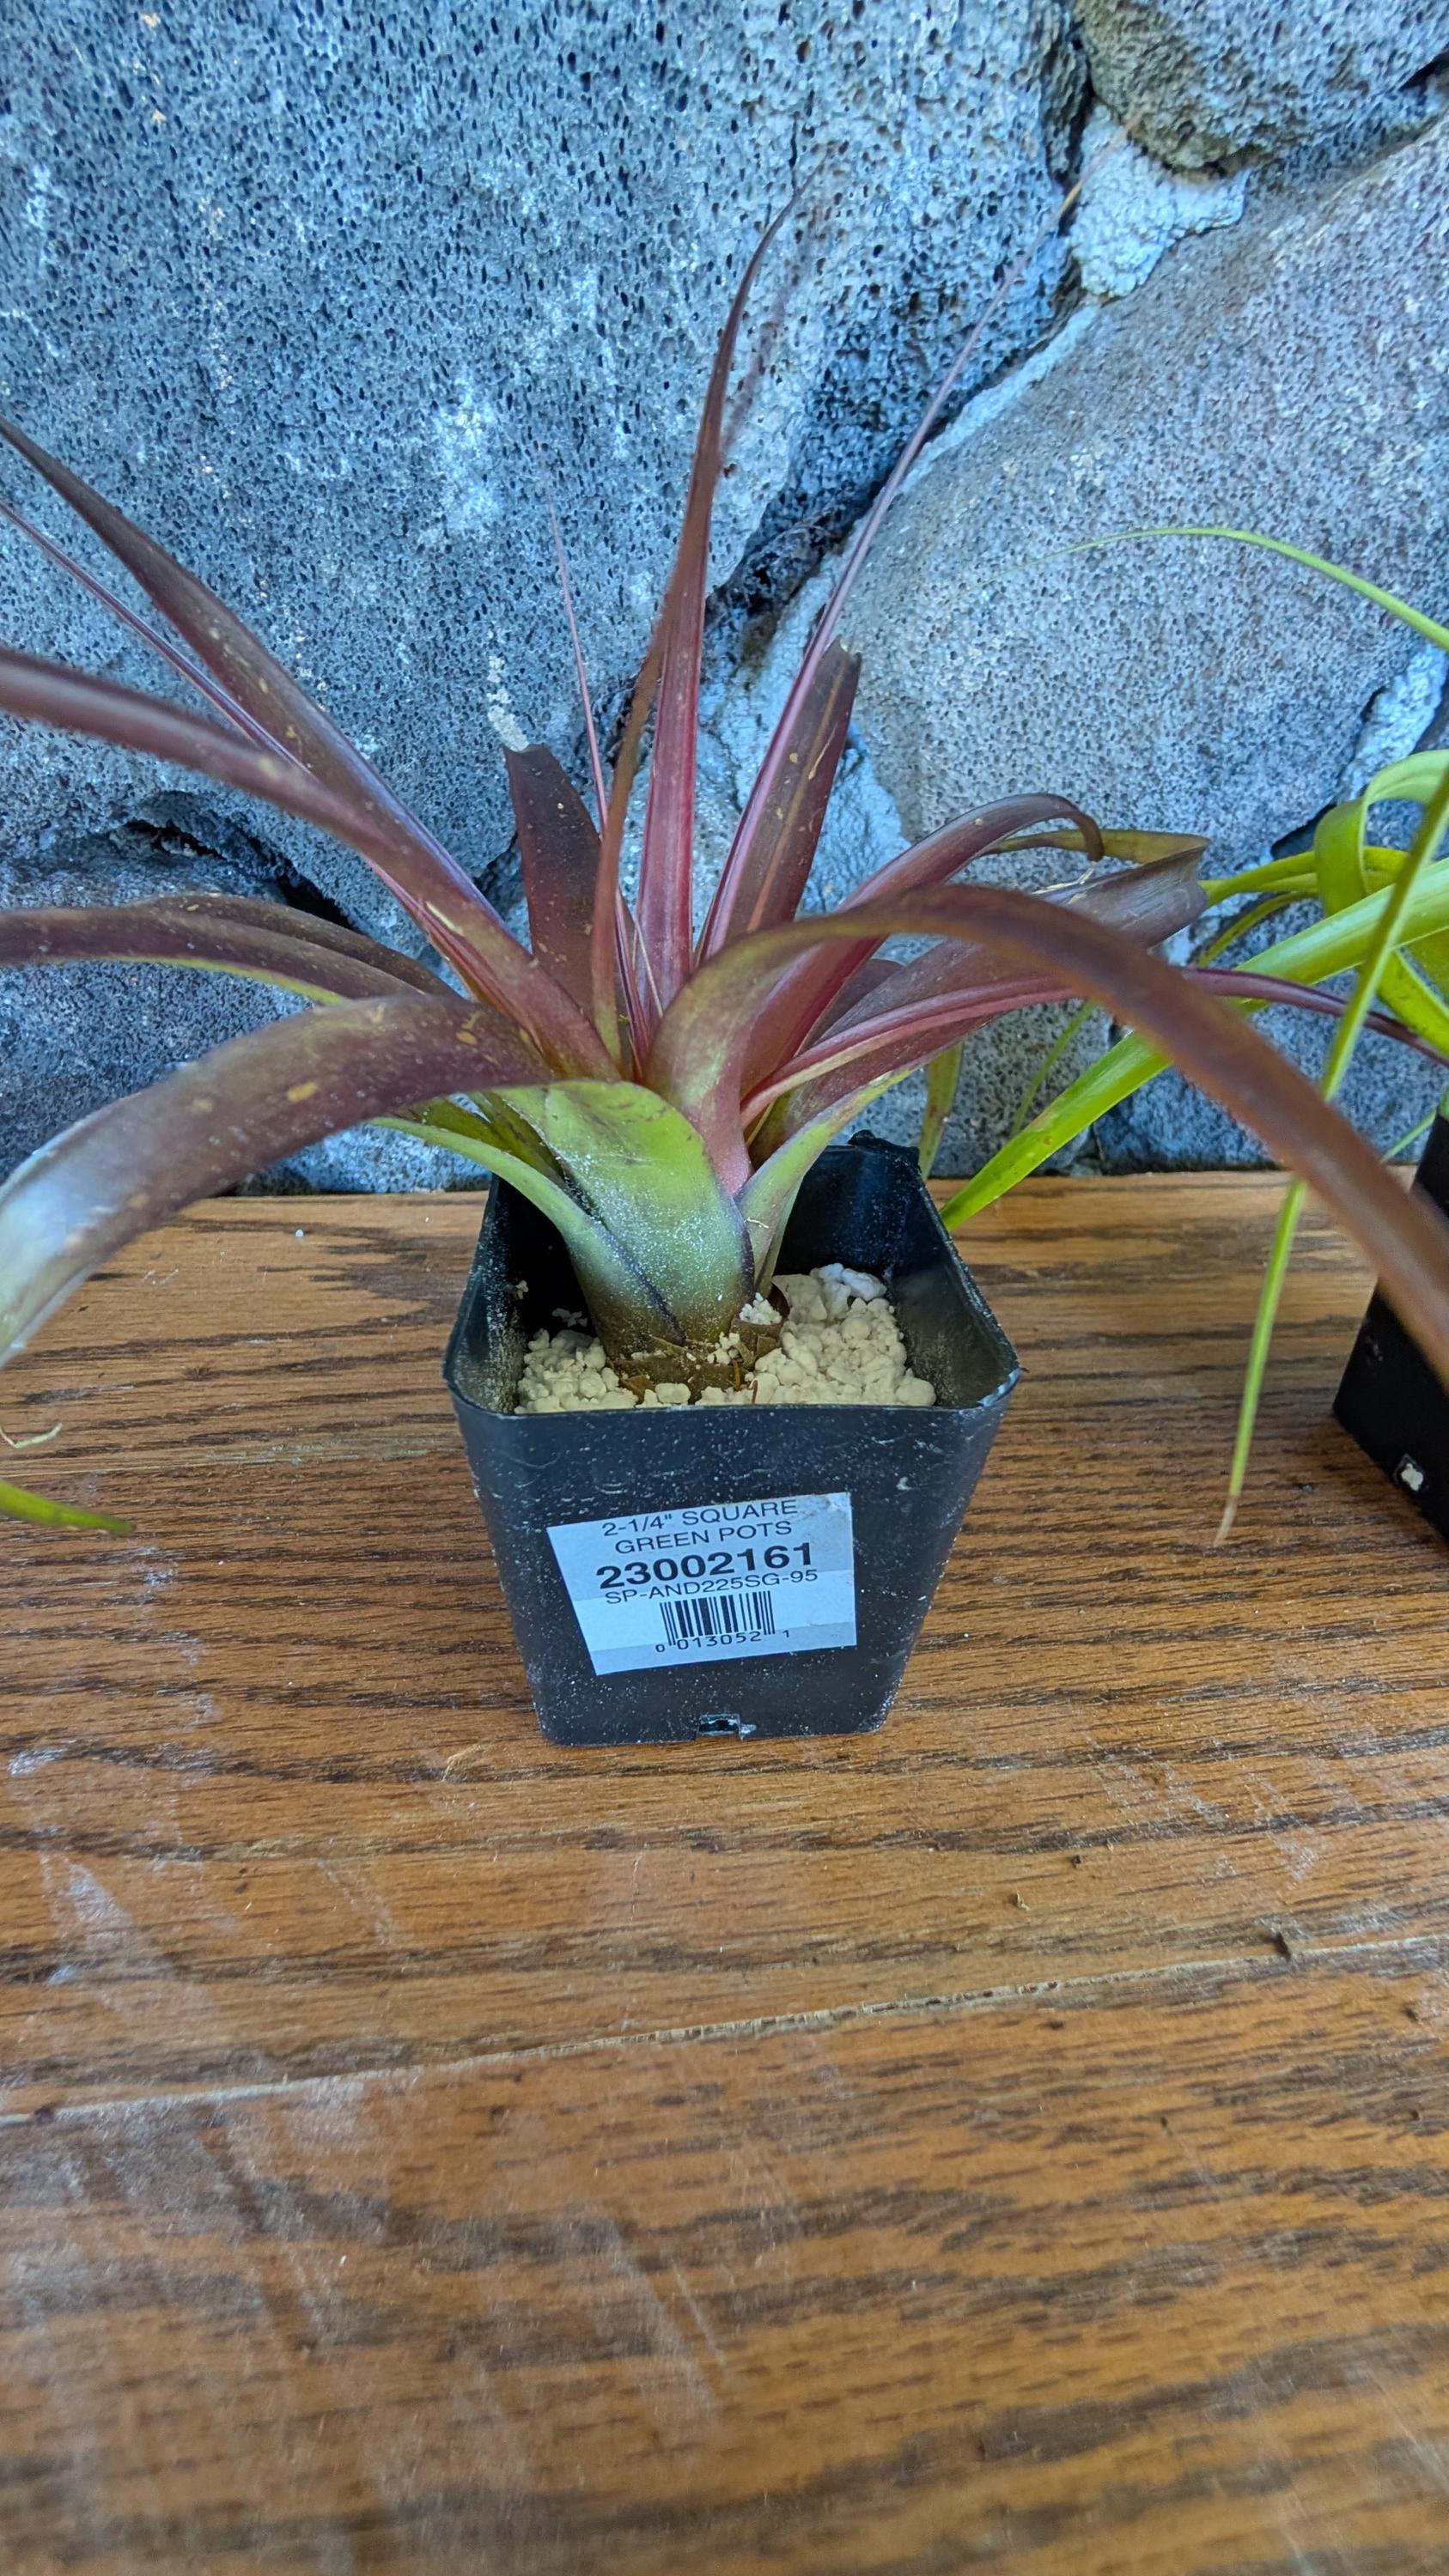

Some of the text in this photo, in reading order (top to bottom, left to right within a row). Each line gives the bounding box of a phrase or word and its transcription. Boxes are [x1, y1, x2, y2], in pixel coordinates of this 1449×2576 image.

[602, 1499, 798, 1537] 2-1/4" SQUARE
[615, 1521, 792, 1554] GREEN POTS
[596, 1542, 813, 1589] 23002161
[606, 1569, 818, 1605] SP-AND225SG-95
[655, 1643, 666, 1653] 0
[677, 1631, 762, 1650] 013052
